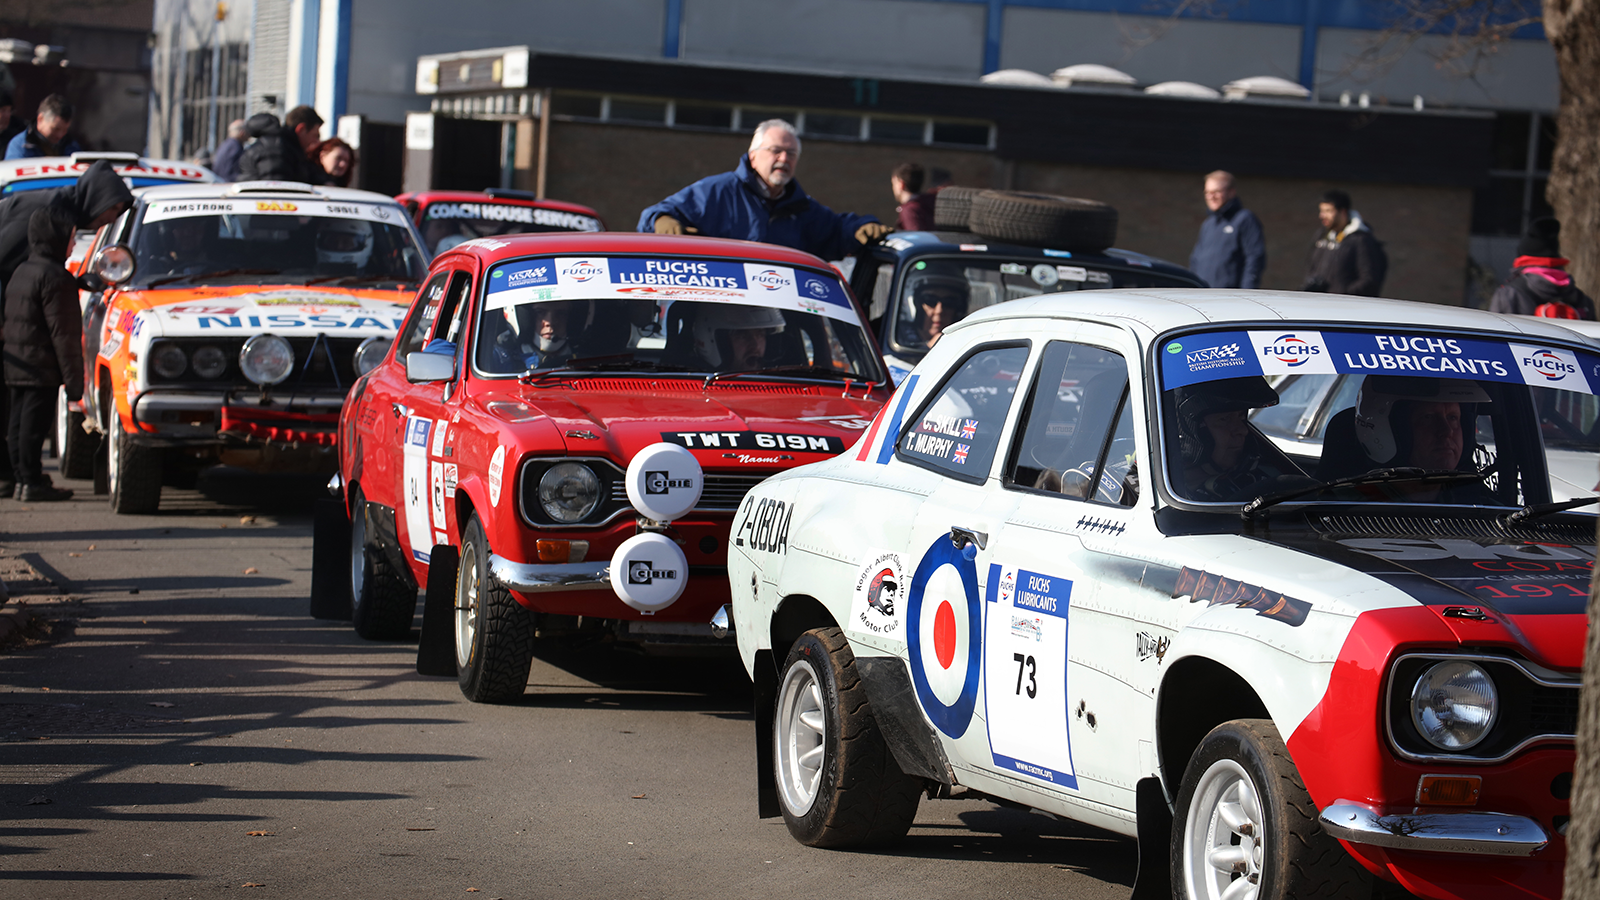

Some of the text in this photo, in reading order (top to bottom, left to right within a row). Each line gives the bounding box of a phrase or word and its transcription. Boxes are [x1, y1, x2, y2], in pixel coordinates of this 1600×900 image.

[15, 163, 203, 179] ENGAND
[163, 203, 233, 213] ARMSTRONG
[256, 201, 298, 212] DAD
[428, 203, 600, 232] COACH HOUSE SERVICES
[508, 270, 532, 281] MSA
[562, 268, 603, 276] FUCHS
[646, 261, 708, 275] FUCHS
[620, 272, 738, 289] LUBRICANTS
[752, 275, 791, 286] FUCHS
[1264, 345, 1320, 356] FUCHS
[1375, 335, 1462, 355] FUCHS
[1186, 350, 1220, 364] MSA
[1344, 353, 1508, 377] LUBRICANTS
[1189, 360, 1246, 372] CHAMPIONSHIP
[1523, 357, 1576, 374] FUCHS
[933, 415, 963, 438] SKILL
[677, 433, 830, 451] TWT 619M
[905, 432, 955, 459] T. MURPHY
[737, 454, 780, 464] Naomi
[856, 564, 873, 591] Roger
[875, 553, 894, 566] Albert
[1000, 581, 1014, 592] FUCHS
[1028, 575, 1051, 594] FUCHS
[1475, 583, 1593, 598] 191
[1017, 590, 1058, 613] LUBRICANTS
[860, 612, 899, 633] Motor Club
[1013, 652, 1037, 699] 73
